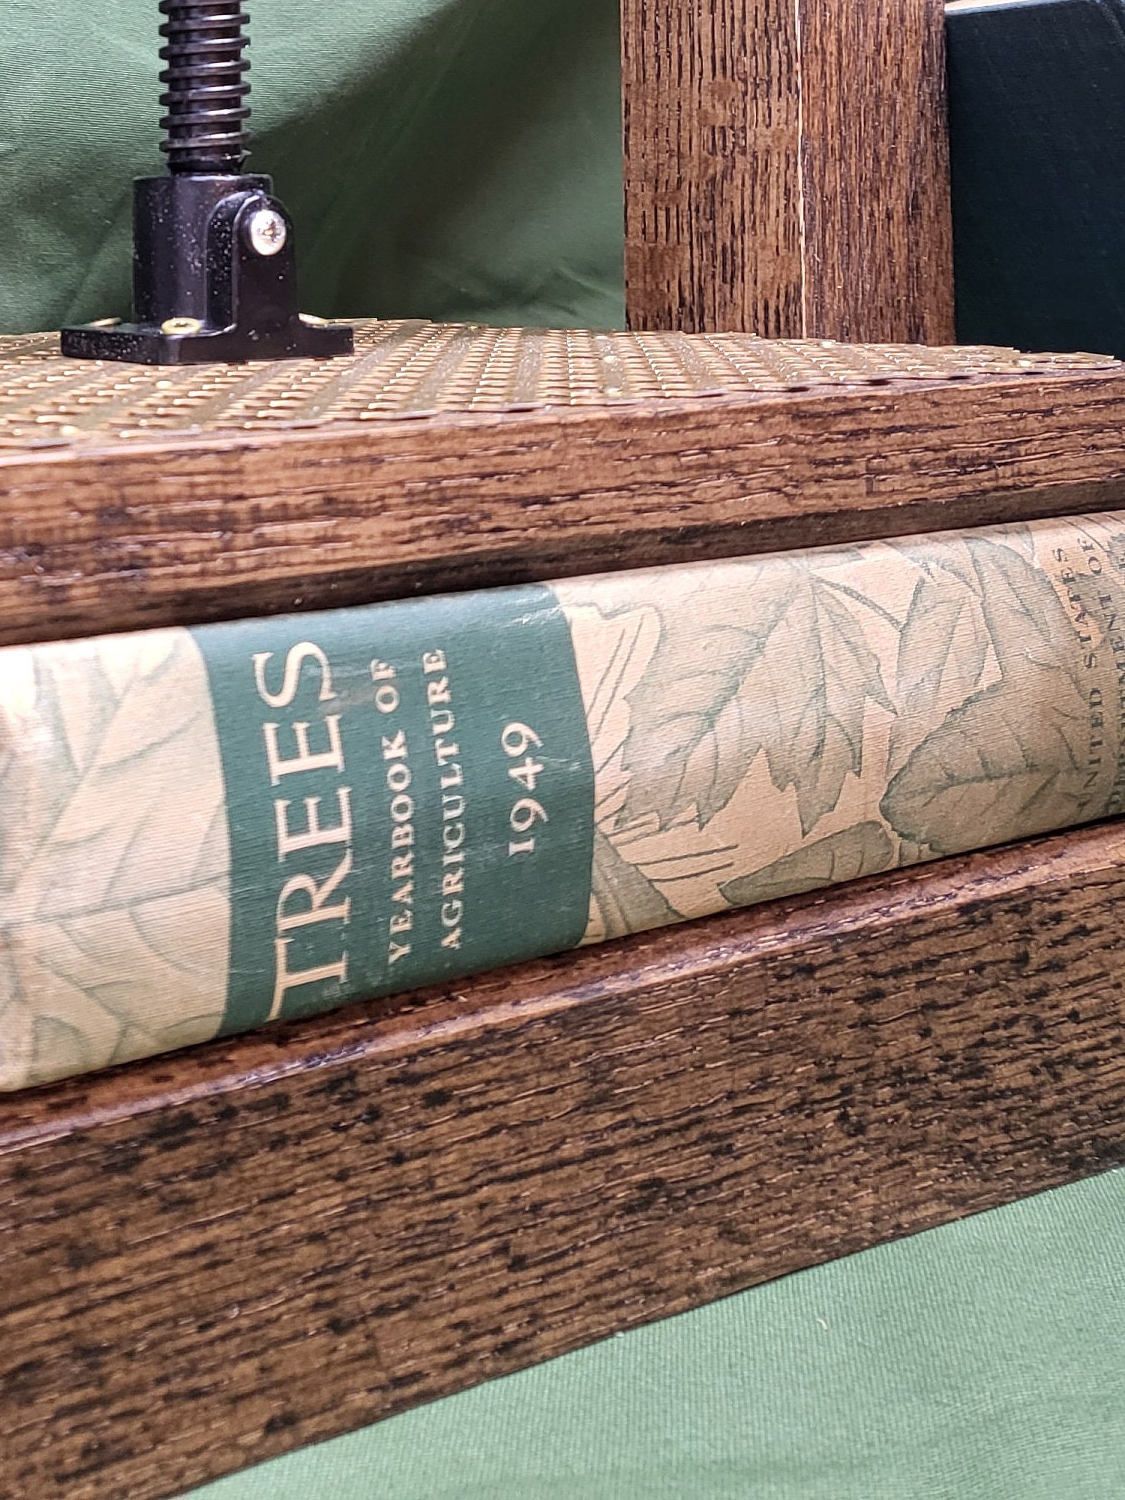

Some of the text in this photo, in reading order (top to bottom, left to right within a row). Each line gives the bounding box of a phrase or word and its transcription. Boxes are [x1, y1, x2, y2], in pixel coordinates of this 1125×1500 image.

[1052, 547, 1104, 808] UNITED STATES
[1077, 536, 1103, 575] OF
[251, 641, 353, 1021] TREES
[370, 658, 415, 965] YEARBOOK OF
[422, 648, 465, 950] AGRICULTURE
[500, 721, 549, 857] 1949
